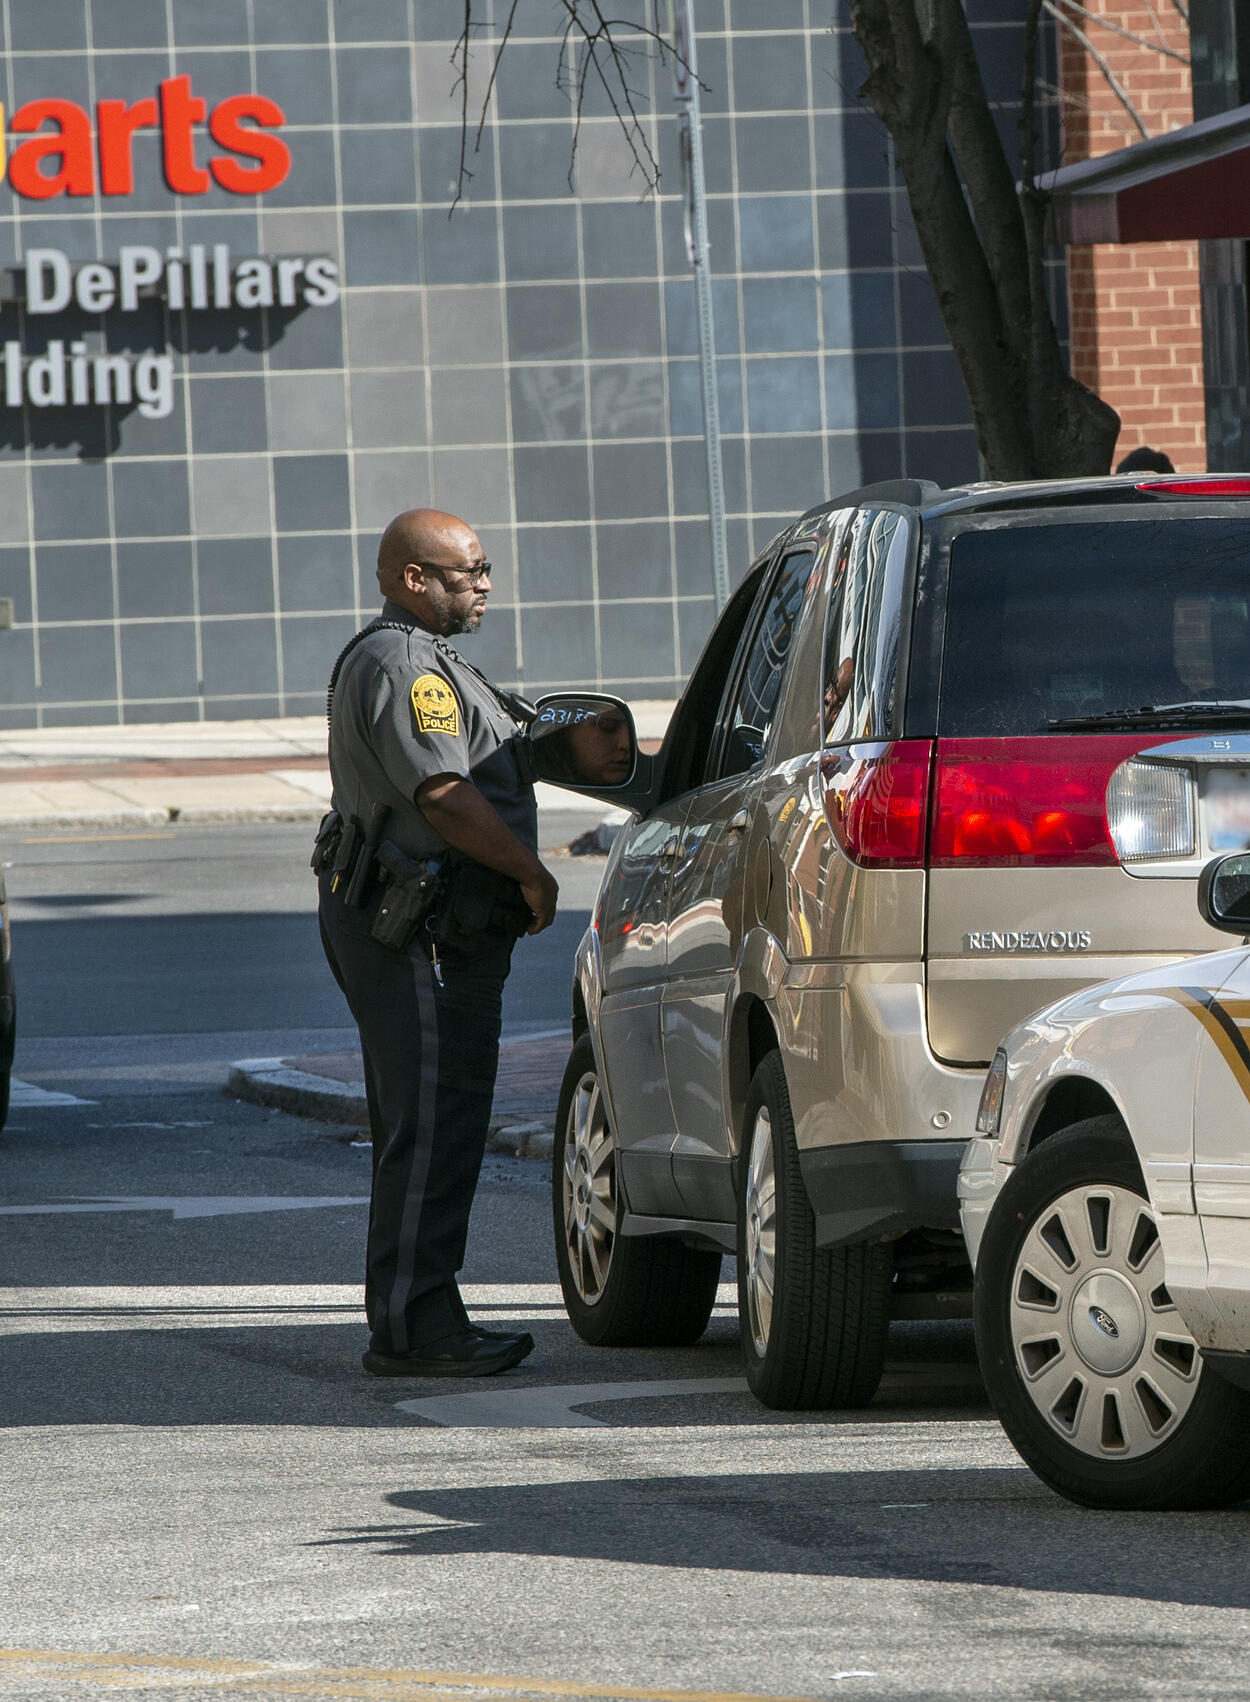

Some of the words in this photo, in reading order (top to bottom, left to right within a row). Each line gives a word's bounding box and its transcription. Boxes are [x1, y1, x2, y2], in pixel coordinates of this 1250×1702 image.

[0, 74, 291, 199] arts
[26, 244, 340, 315] DePillars
[423, 719, 456, 731] POLICE
[968, 930, 1092, 950] RENDEZVOUS
[1096, 1310, 1115, 1333] Ford
